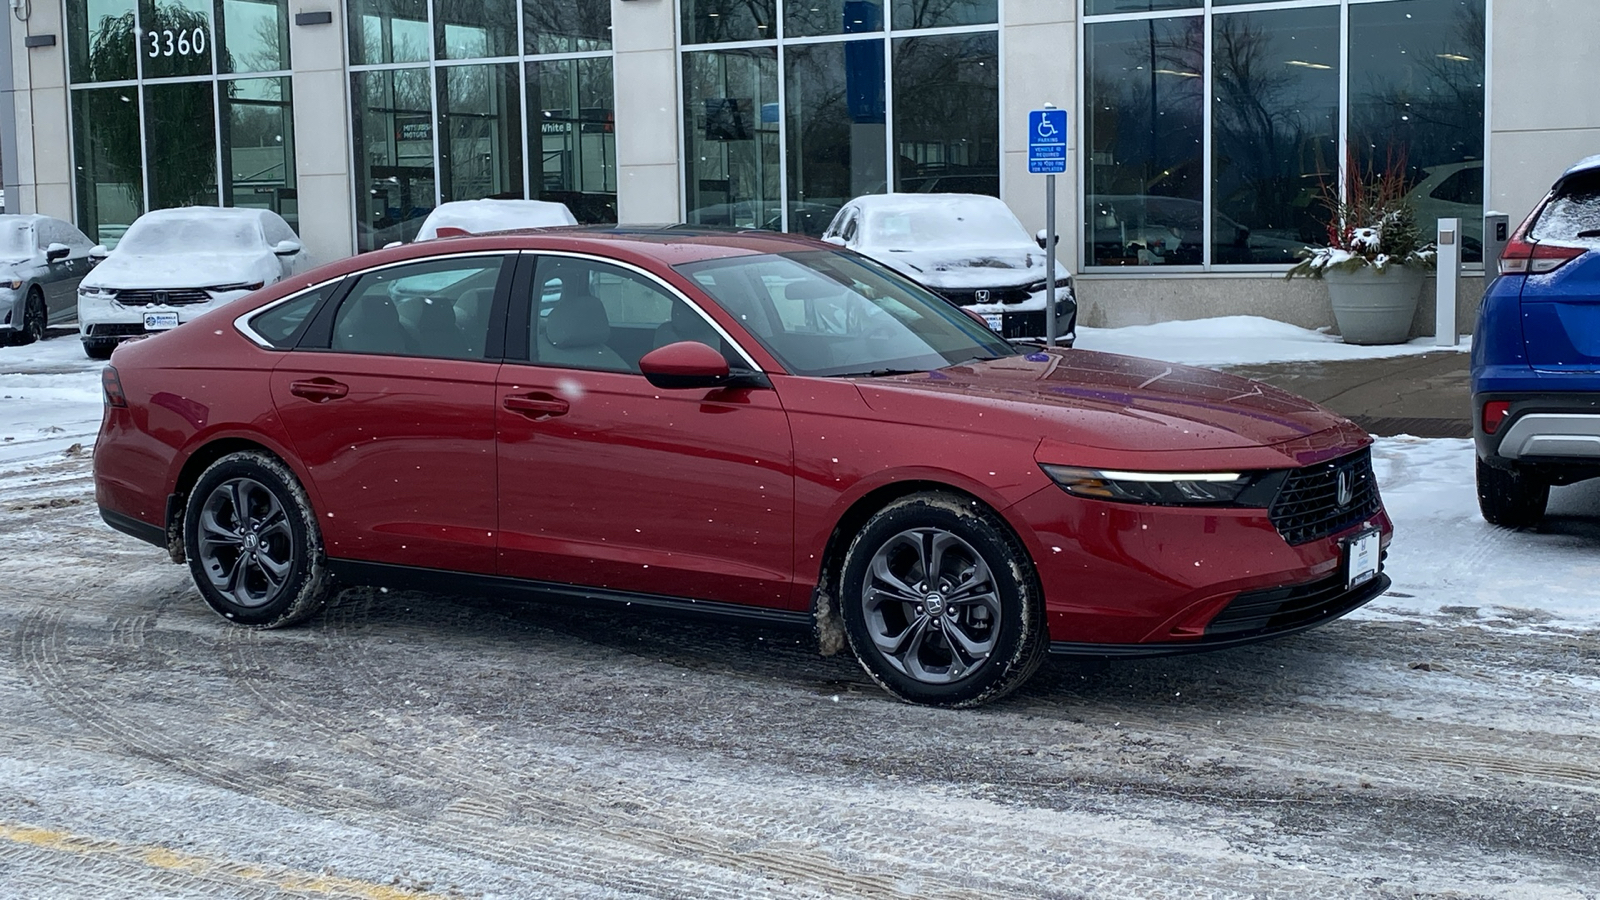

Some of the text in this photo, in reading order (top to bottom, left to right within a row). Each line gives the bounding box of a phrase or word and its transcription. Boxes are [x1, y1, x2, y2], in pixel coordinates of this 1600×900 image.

[148, 27, 205, 58] 3360
[541, 123, 585, 132] White Br
